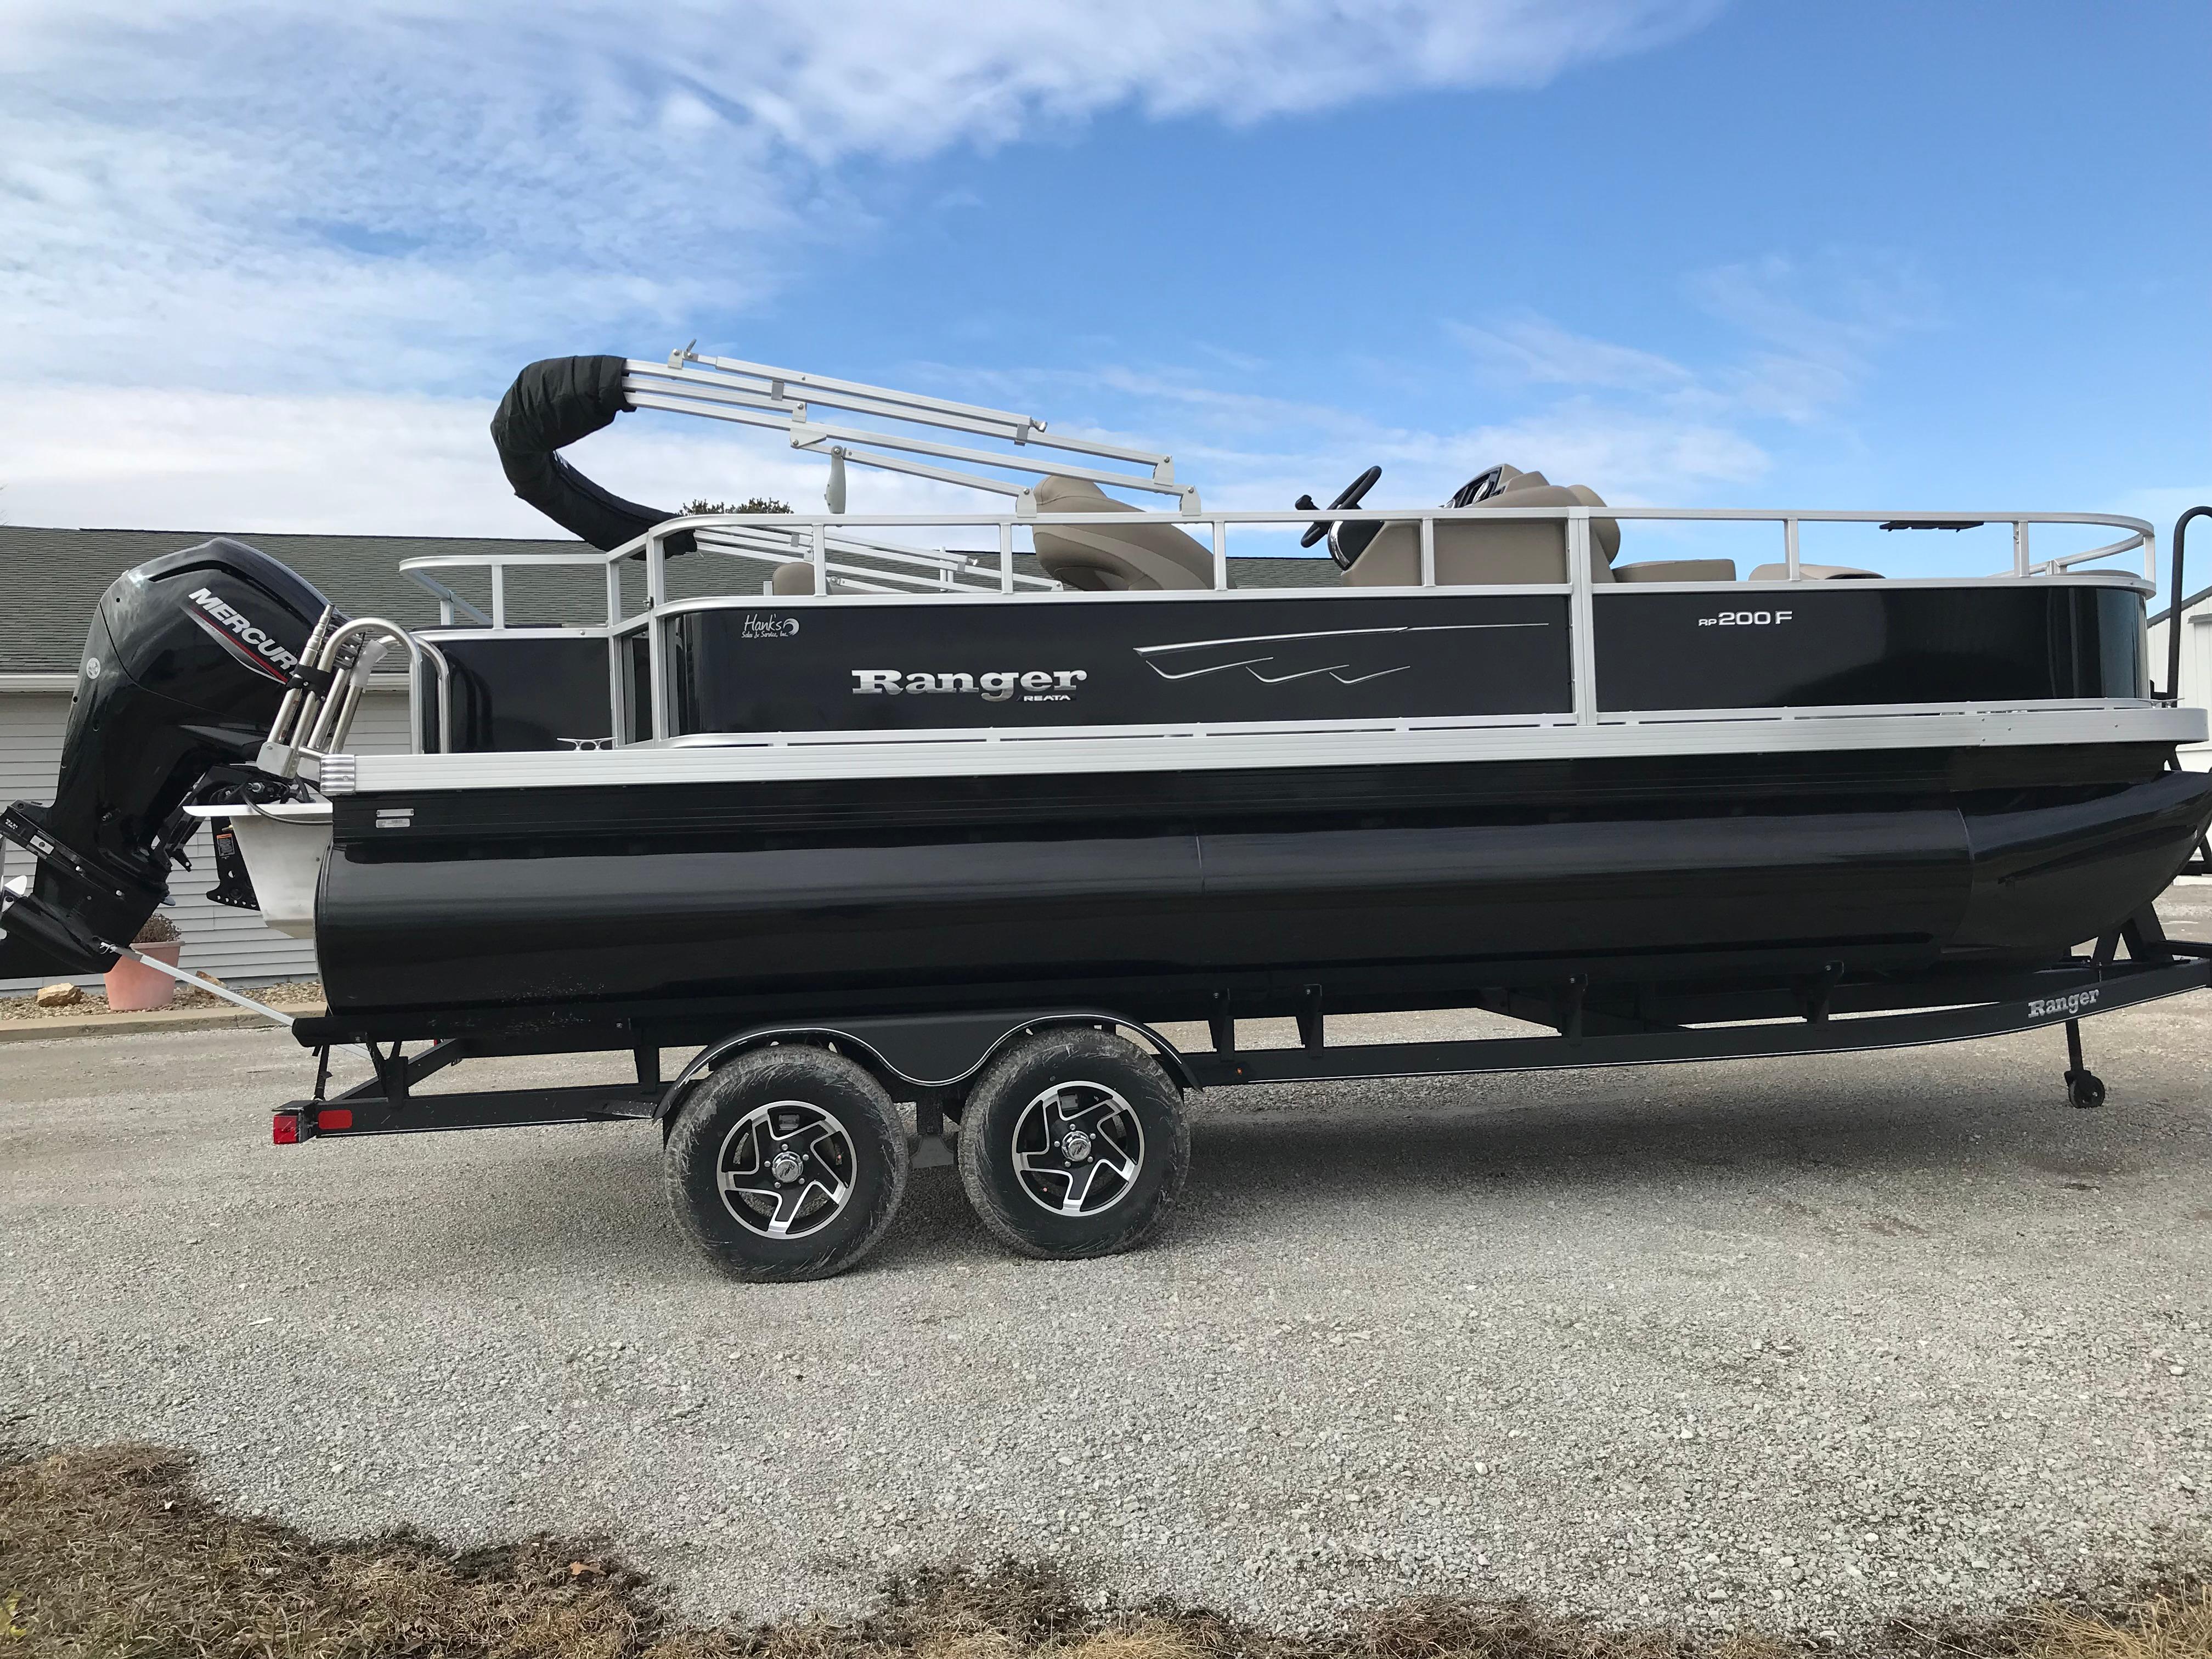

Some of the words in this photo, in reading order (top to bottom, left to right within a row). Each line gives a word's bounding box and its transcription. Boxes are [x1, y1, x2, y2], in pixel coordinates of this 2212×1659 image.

[744, 613, 782, 631] Hank's
[851, 669, 1087, 702] Ranger
[2028, 989, 2100, 1018] Ranger
